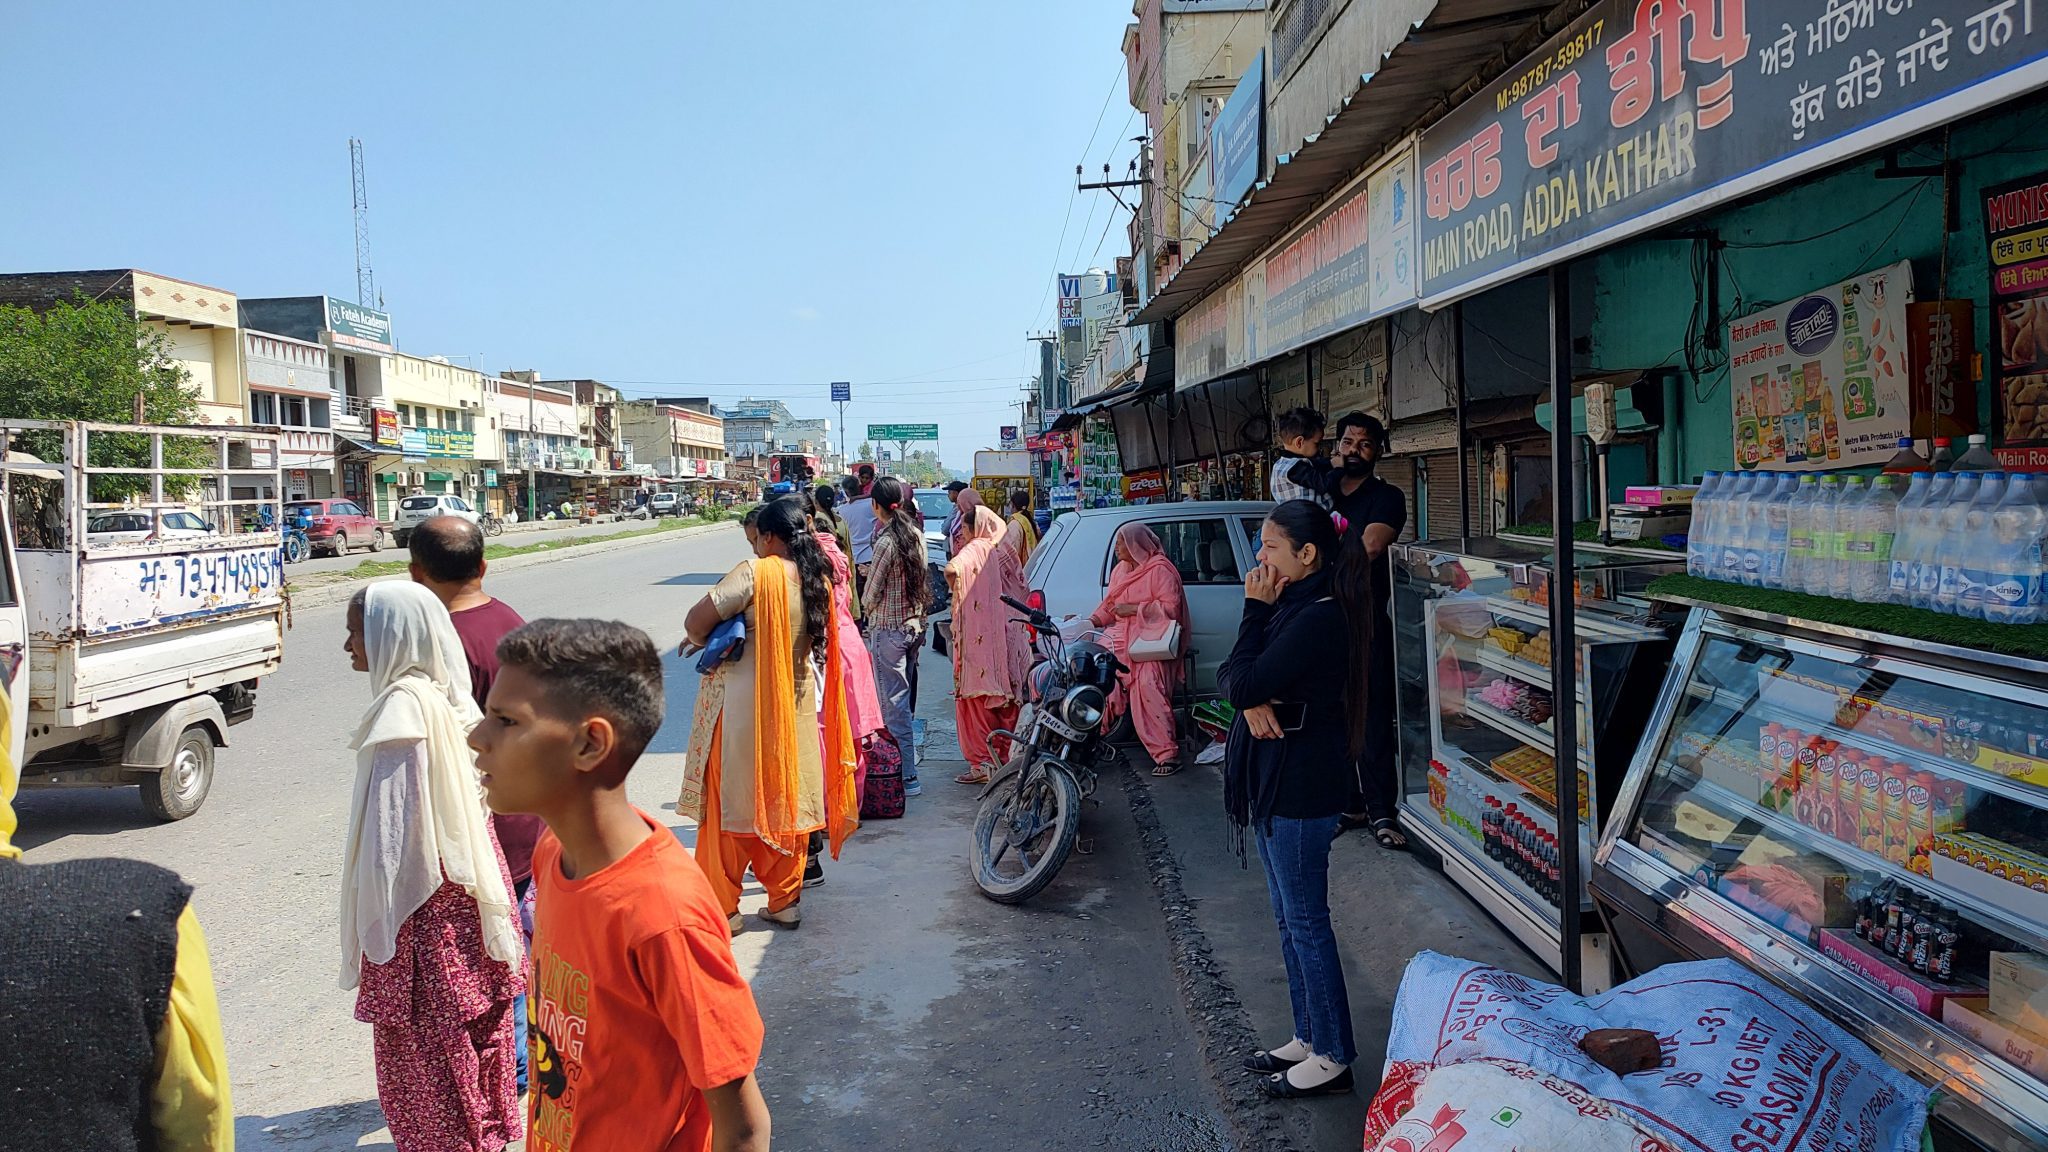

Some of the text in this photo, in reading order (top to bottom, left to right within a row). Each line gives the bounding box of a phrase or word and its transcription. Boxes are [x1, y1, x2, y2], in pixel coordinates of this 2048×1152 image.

[1496, 19, 1604, 112] M:98787-59817
[1758, 23, 1798, 75] ਅਤੇ
[1789, 80, 1827, 140] ਬੁੱਕ
[1836, 48, 1886, 110] ਕੀਤੇ
[1896, 17, 1953, 88] ਜਾਂਦੇ
[1521, 70, 1581, 169] ਦਾ
[1424, 110, 1697, 282] MAIN ROAD, ADDA KATHAR
[340, 305, 361, 323] Fateh
[360, 311, 388, 334] Academy
[1796, 307, 1828, 343] METRO
[1997, 451, 2026, 466] Main
[1995, 585, 2023, 597] kinley
[1824, 945, 1861, 973] SANDWICH
[1690, 1007, 1731, 1046] L-31
[1735, 1016, 1778, 1055] NETT
[1722, 1057, 1761, 1089] KG
[1731, 1066, 1810, 1152] SEASON
